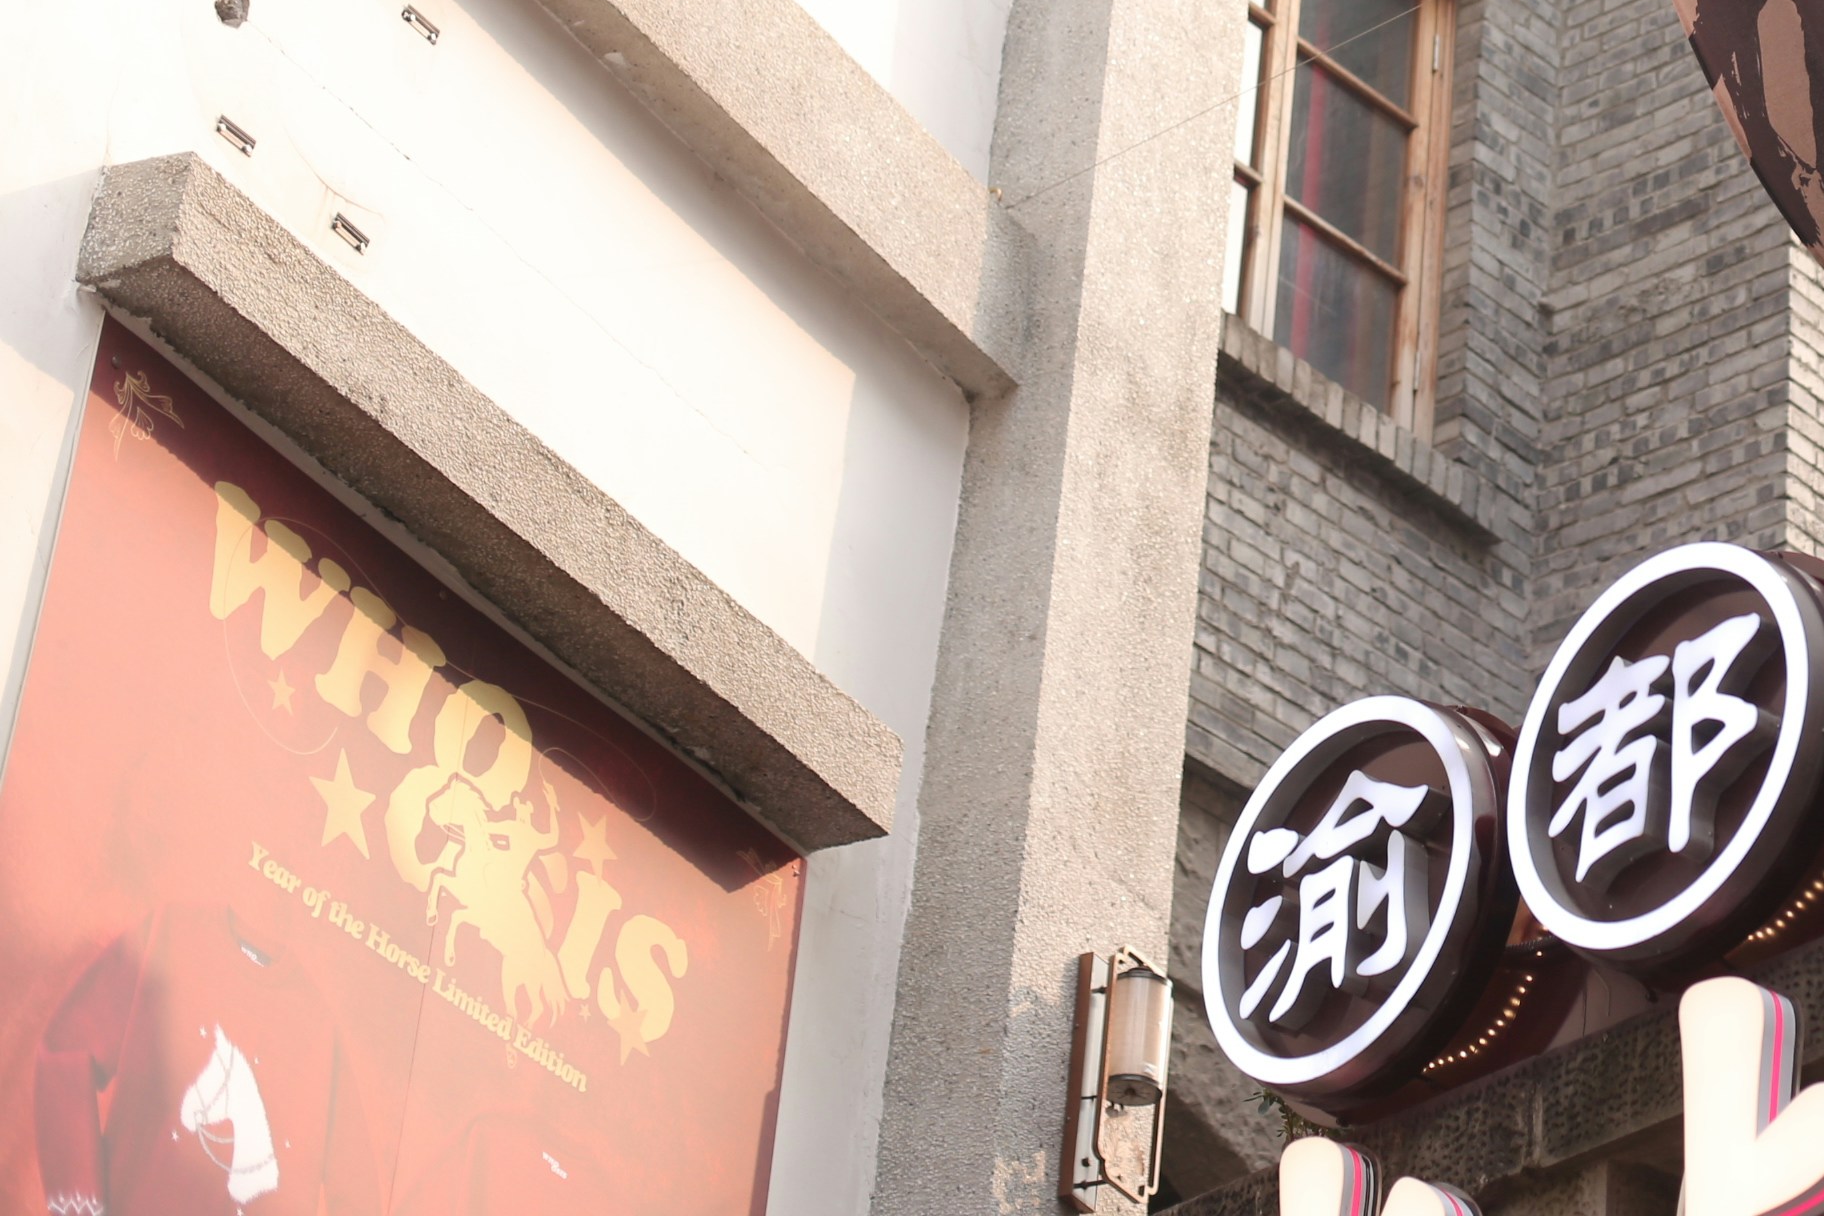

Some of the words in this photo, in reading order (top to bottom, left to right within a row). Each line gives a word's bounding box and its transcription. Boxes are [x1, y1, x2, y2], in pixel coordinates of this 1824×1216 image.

[209, 481, 536, 812] WHO
[248, 841, 301, 894] Year
[302, 887, 331, 918] of
[328, 901, 364, 940] the
[365, 923, 431, 983] Horse
[432, 968, 513, 1041] Limited
[513, 1023, 587, 1093] Edition
